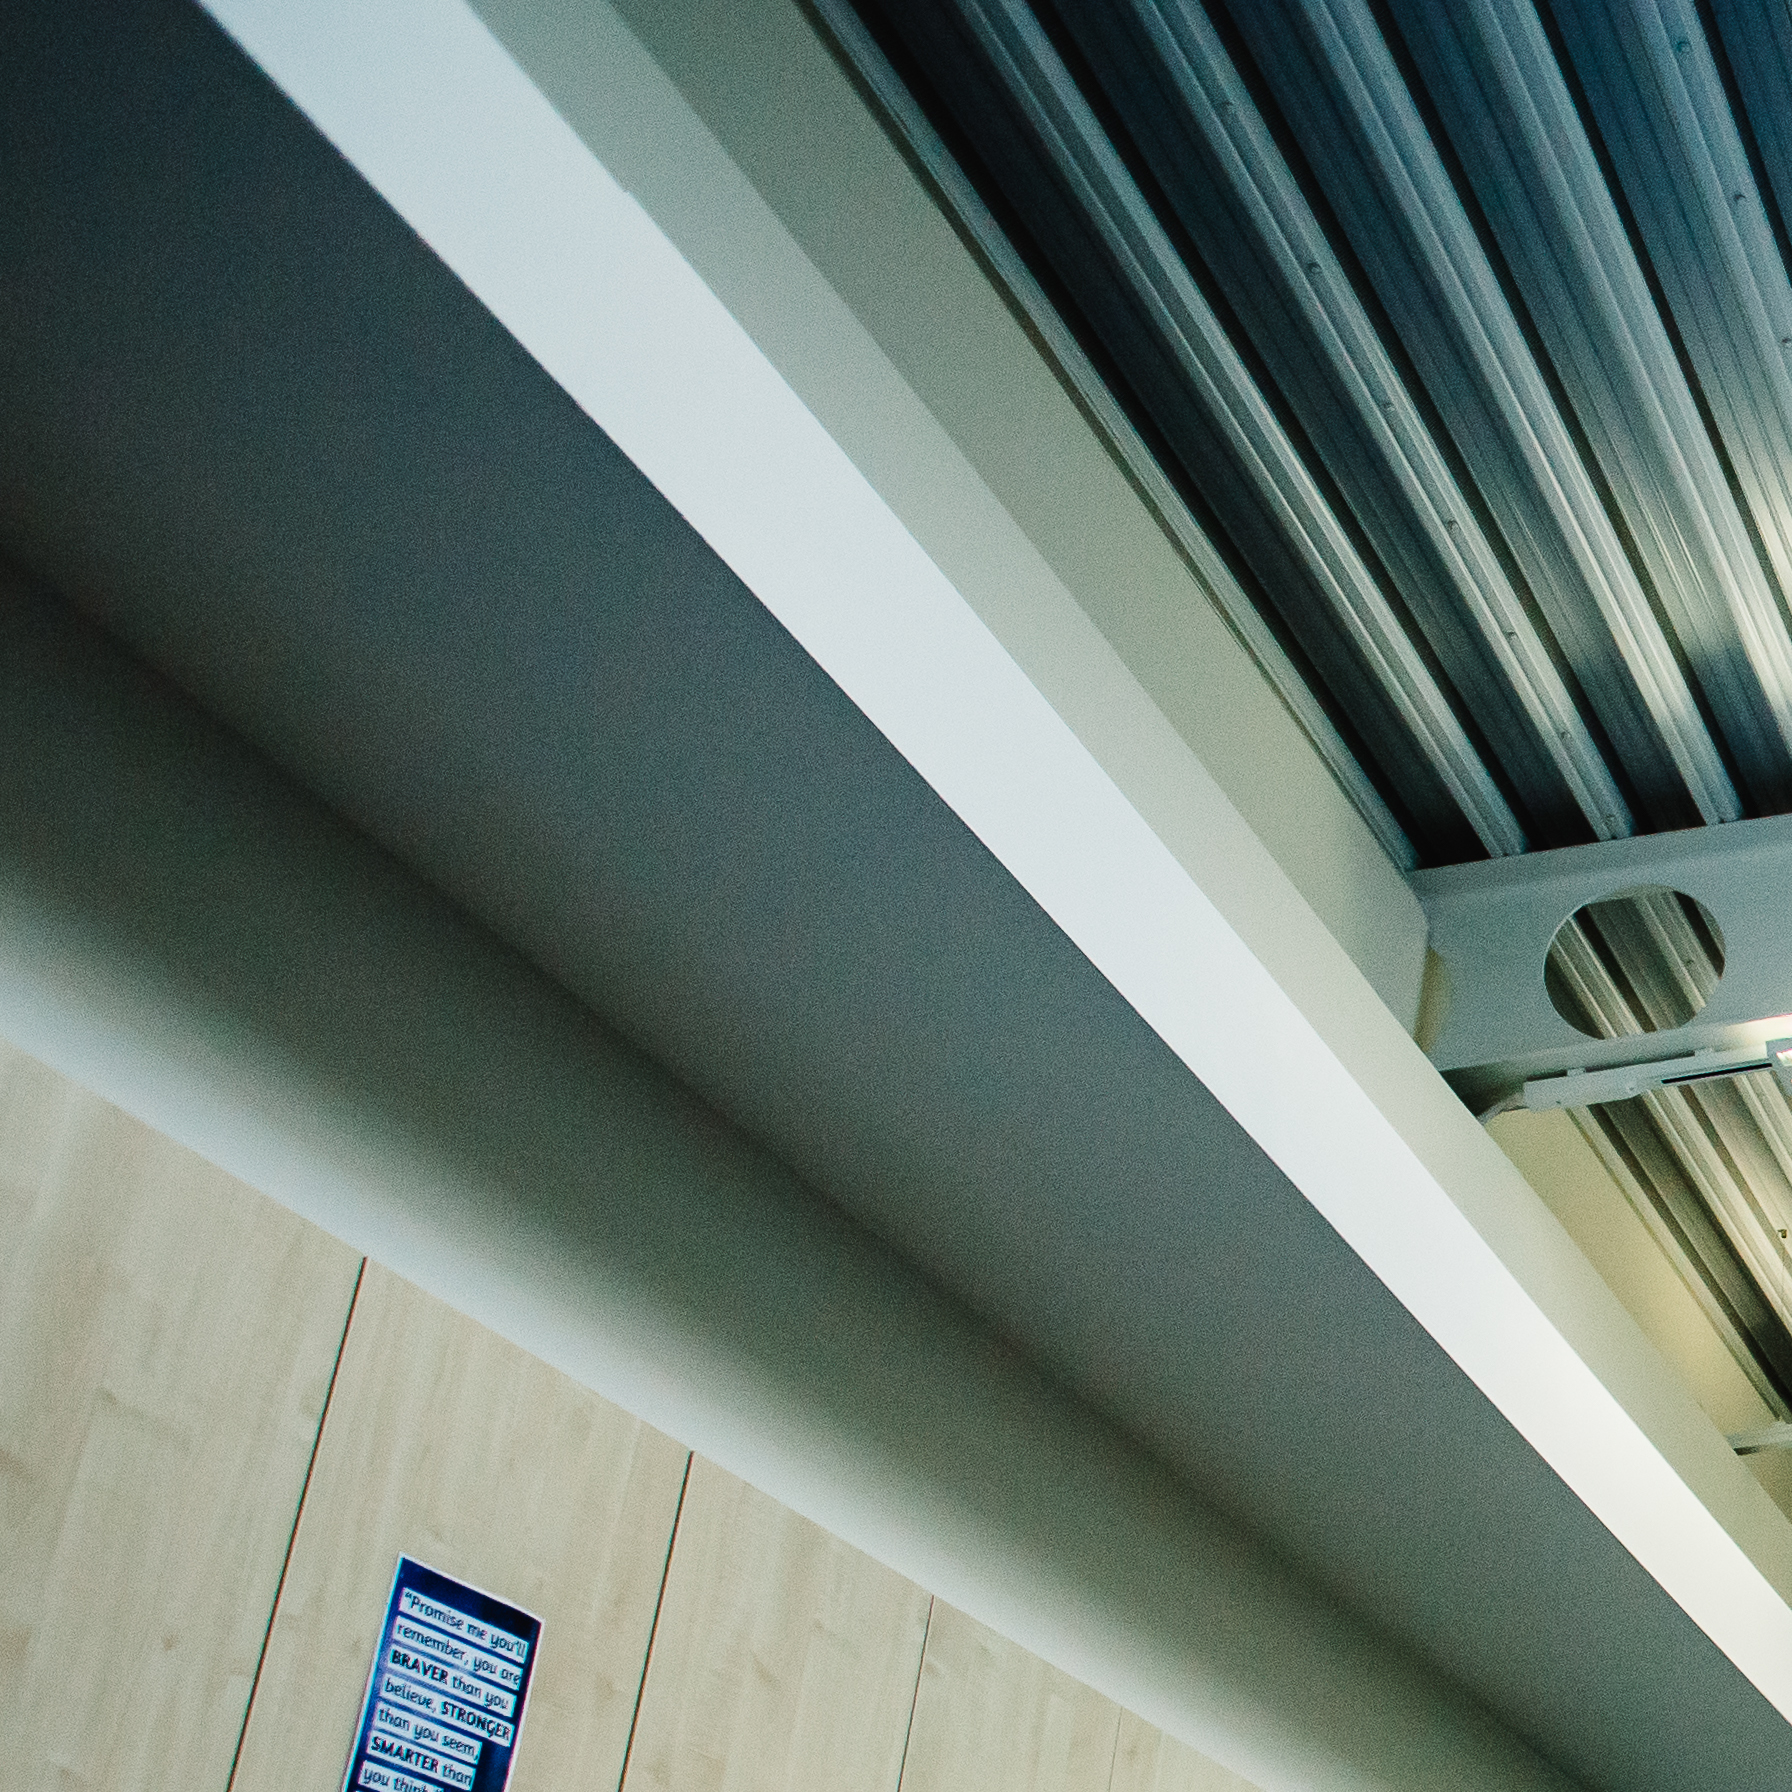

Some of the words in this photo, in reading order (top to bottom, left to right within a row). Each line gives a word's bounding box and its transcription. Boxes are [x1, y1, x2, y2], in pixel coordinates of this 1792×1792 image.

[397, 1624, 468, 1666] remember,
[473, 1656, 498, 1674] you
[501, 1668, 522, 1686] are
[467, 1622, 488, 1640] me
[390, 1649, 449, 1685] BRAVER
[452, 1676, 482, 1699] than
[484, 1691, 509, 1710] you
[378, 1707, 411, 1732] than
[413, 1723, 440, 1743] you
[442, 1734, 479, 1761] seem,
[383, 1677, 436, 1714] believe,
[440, 1700, 511, 1741] STRONGER
[363, 1768, 391, 1787] you
[371, 1736, 439, 1774] SMARTER
[442, 1763, 472, 1787] than
